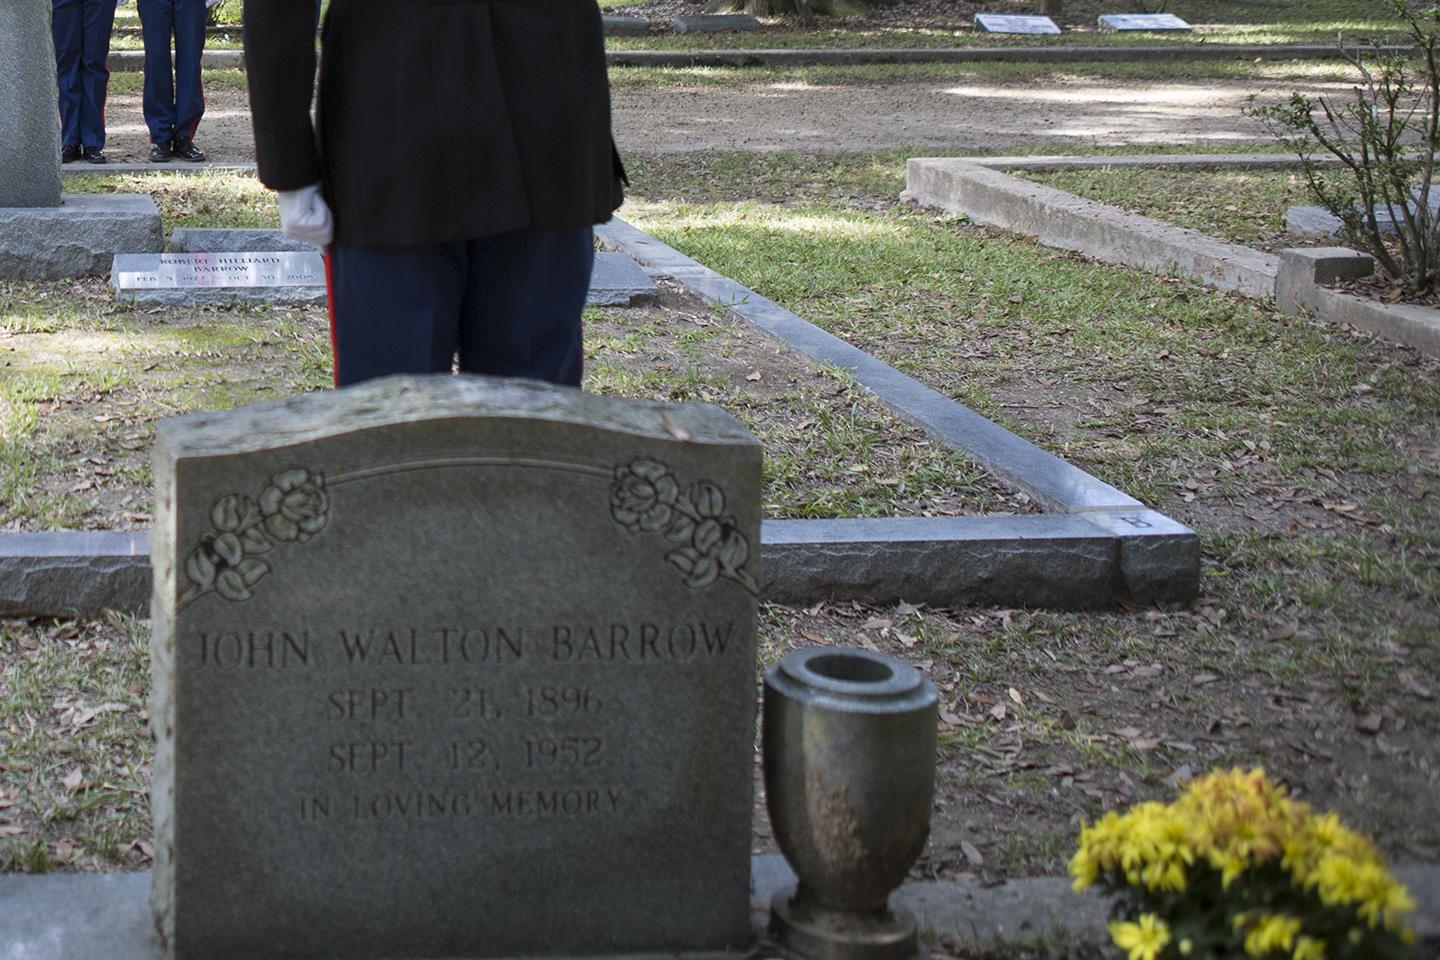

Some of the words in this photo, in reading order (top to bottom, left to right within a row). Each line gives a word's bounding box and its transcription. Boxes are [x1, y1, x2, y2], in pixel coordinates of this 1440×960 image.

[191, 631, 310, 670] JOHN
[339, 626, 523, 666] WALTON
[552, 622, 736, 662] BARROW
[526, 686, 603, 717] 1896
[525, 736, 604, 769] 1952
[300, 795, 330, 822] IN
[354, 793, 472, 819] LOVING
[490, 789, 624, 816] MEMORY
